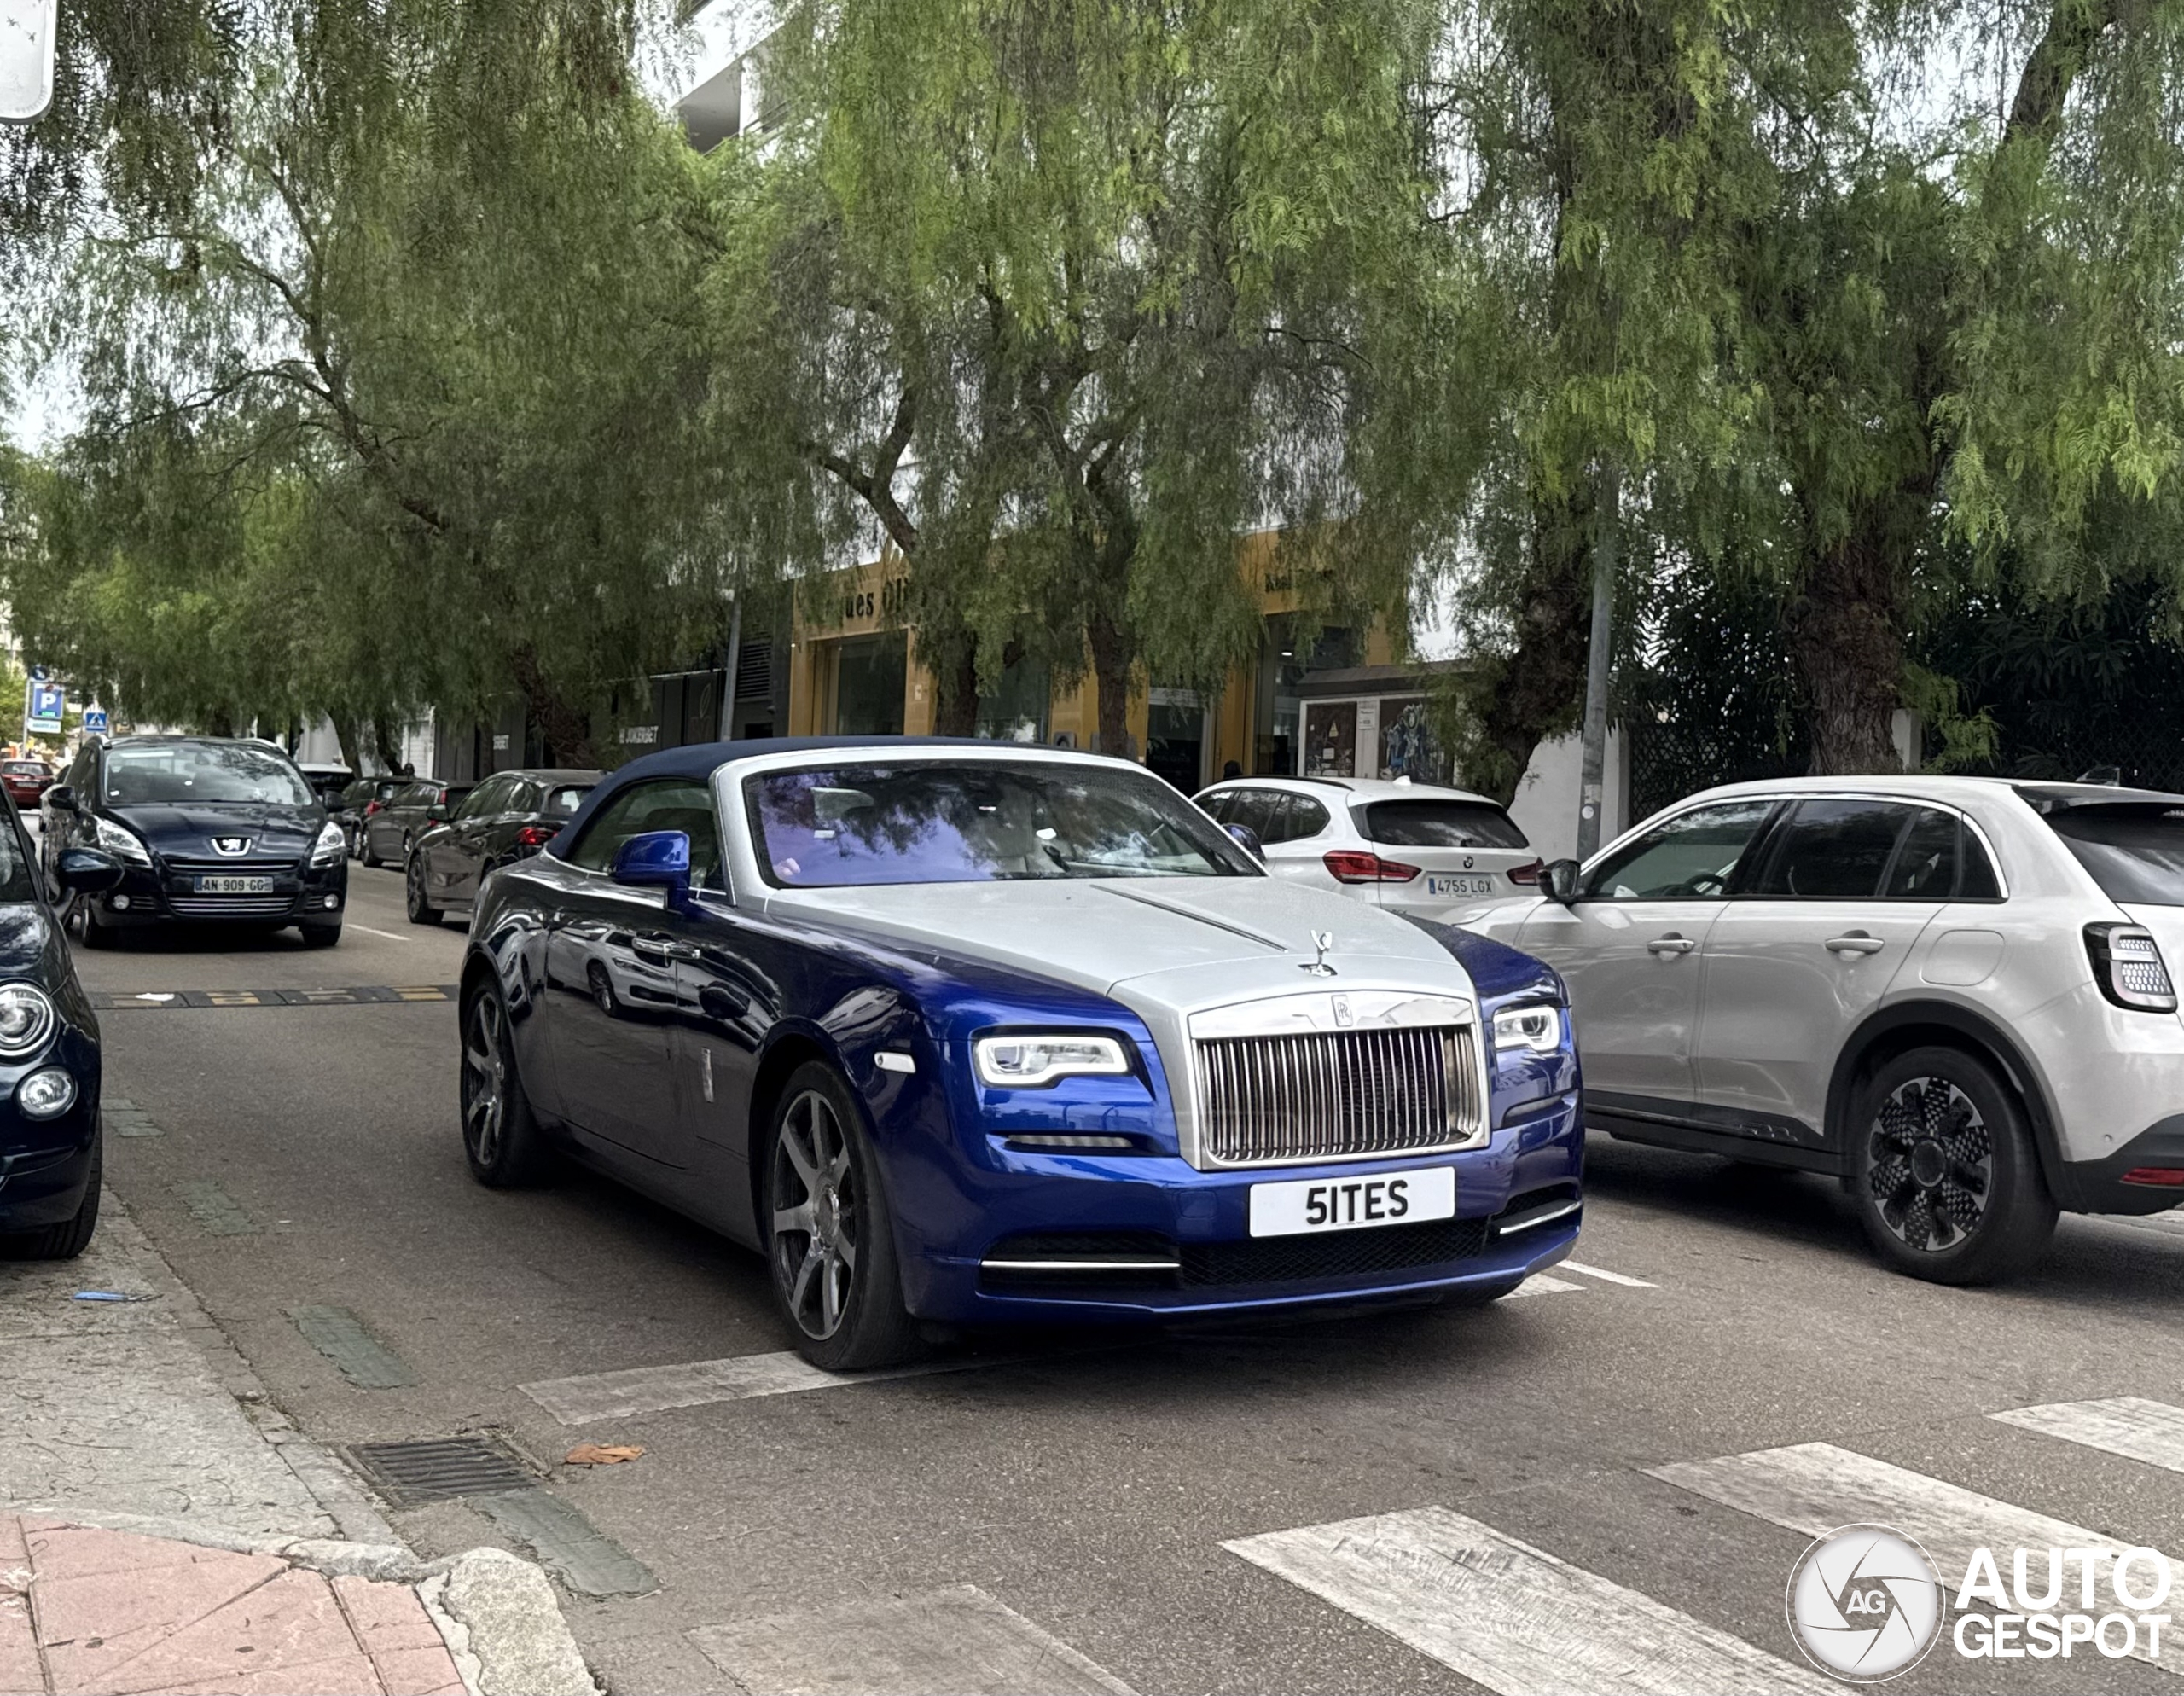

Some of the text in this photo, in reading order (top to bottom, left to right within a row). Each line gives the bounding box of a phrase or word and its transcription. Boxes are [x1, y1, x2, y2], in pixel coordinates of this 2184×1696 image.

[40, 693, 56, 709] P
[1438, 880, 1492, 893] 4755 LGX
